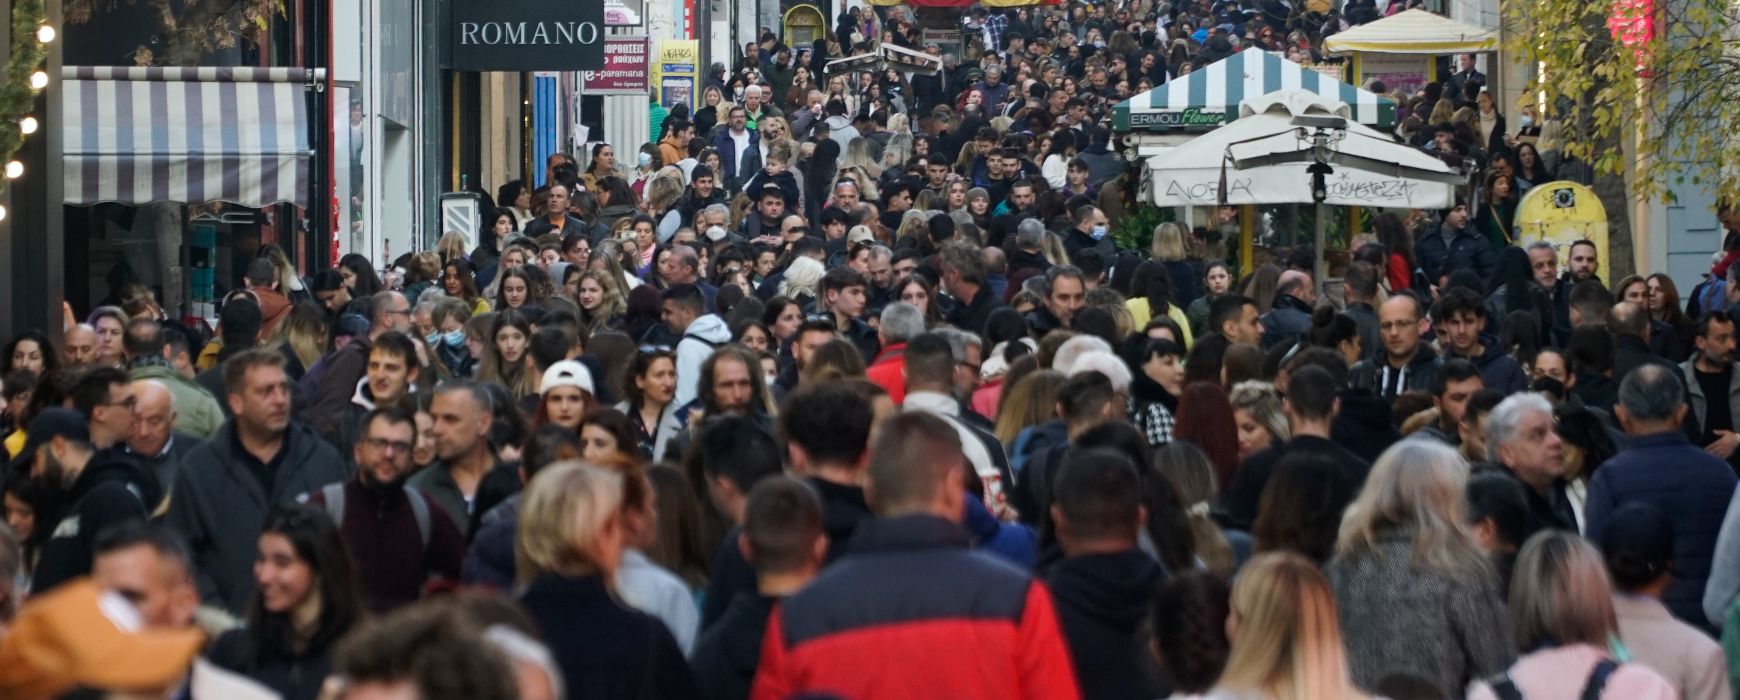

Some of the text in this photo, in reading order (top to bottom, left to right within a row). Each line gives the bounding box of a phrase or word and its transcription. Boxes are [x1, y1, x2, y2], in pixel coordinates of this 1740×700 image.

[461, 22, 597, 44] ROMANO
[1131, 108, 1224, 124] ERMOU Flower
